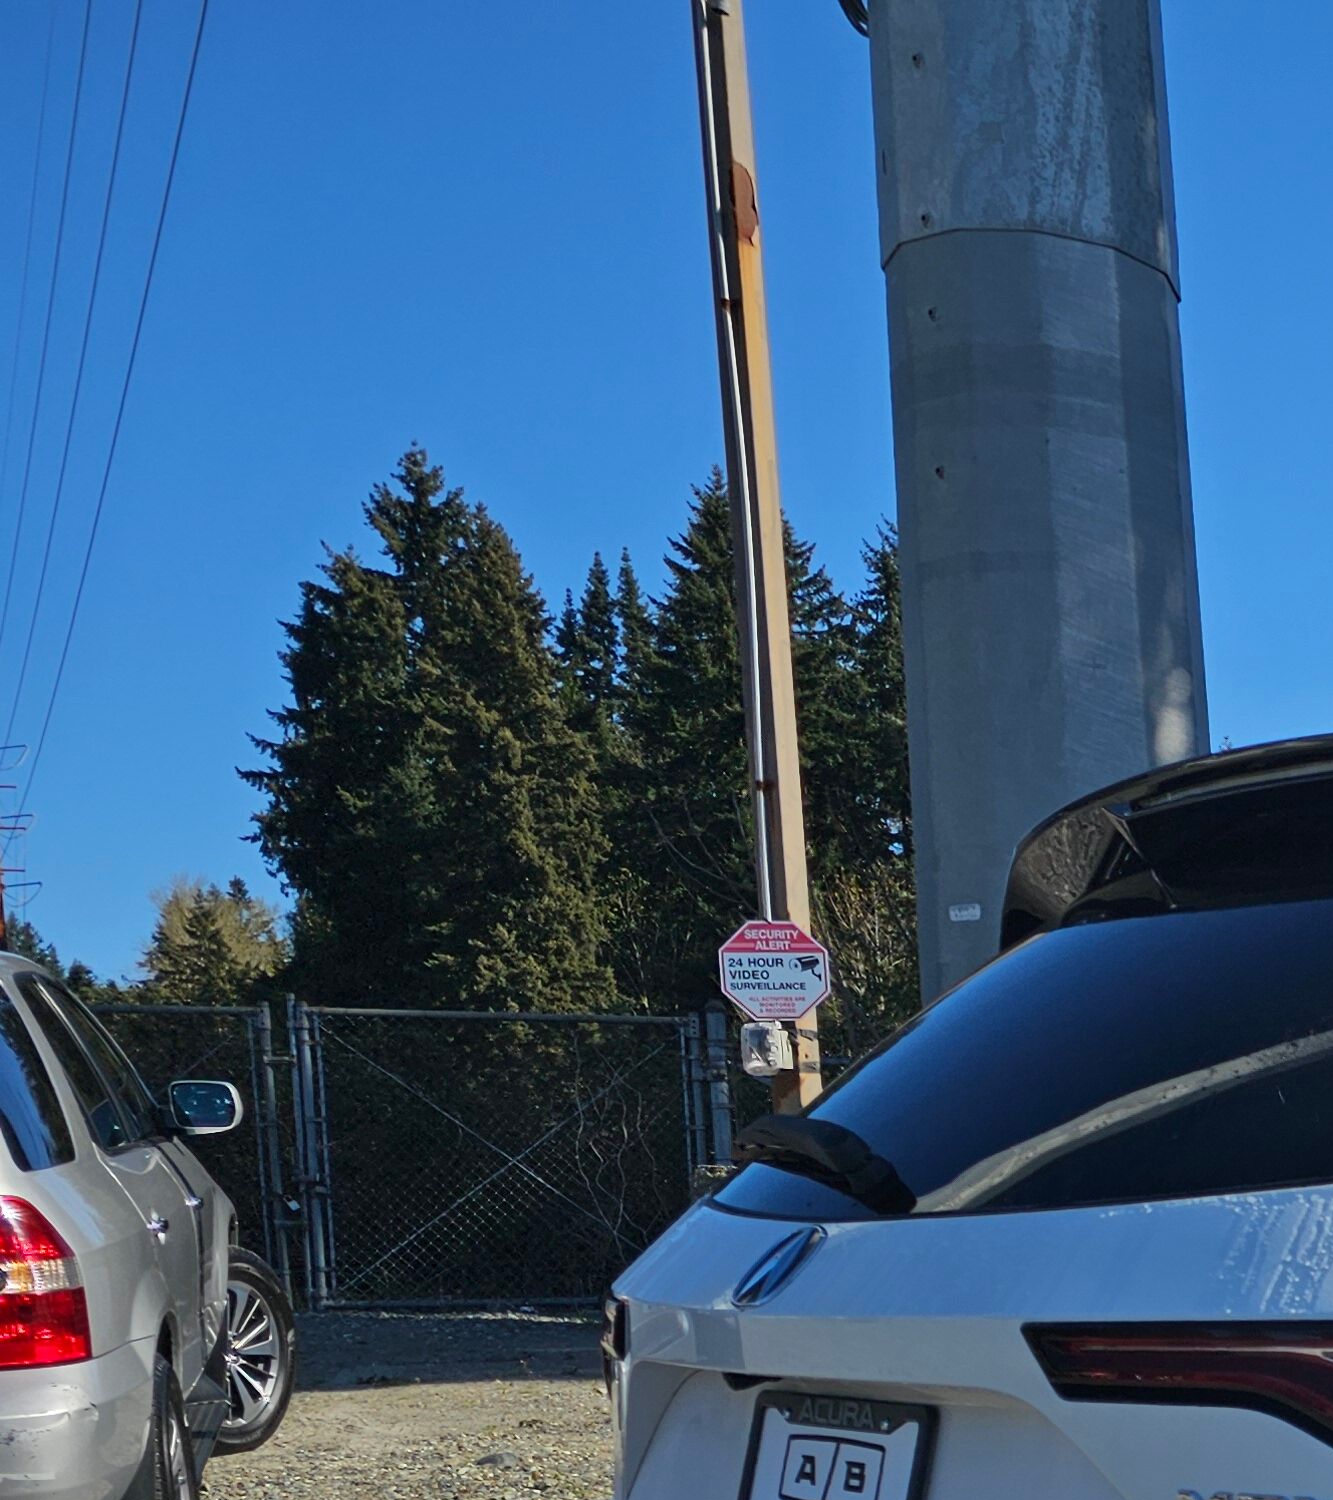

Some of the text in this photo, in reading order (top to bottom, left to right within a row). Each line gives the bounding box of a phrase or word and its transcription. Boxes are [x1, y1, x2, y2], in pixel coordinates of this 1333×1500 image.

[744, 929, 799, 940] SECURITY
[755, 941, 791, 950] ALERT
[728, 957, 784, 968] 24 HOUR
[729, 970, 770, 980] VIDEO
[730, 982, 807, 990] SURVEILLANCE
[798, 1398, 875, 1430] ACURA
[794, 1455, 867, 1494] A B
